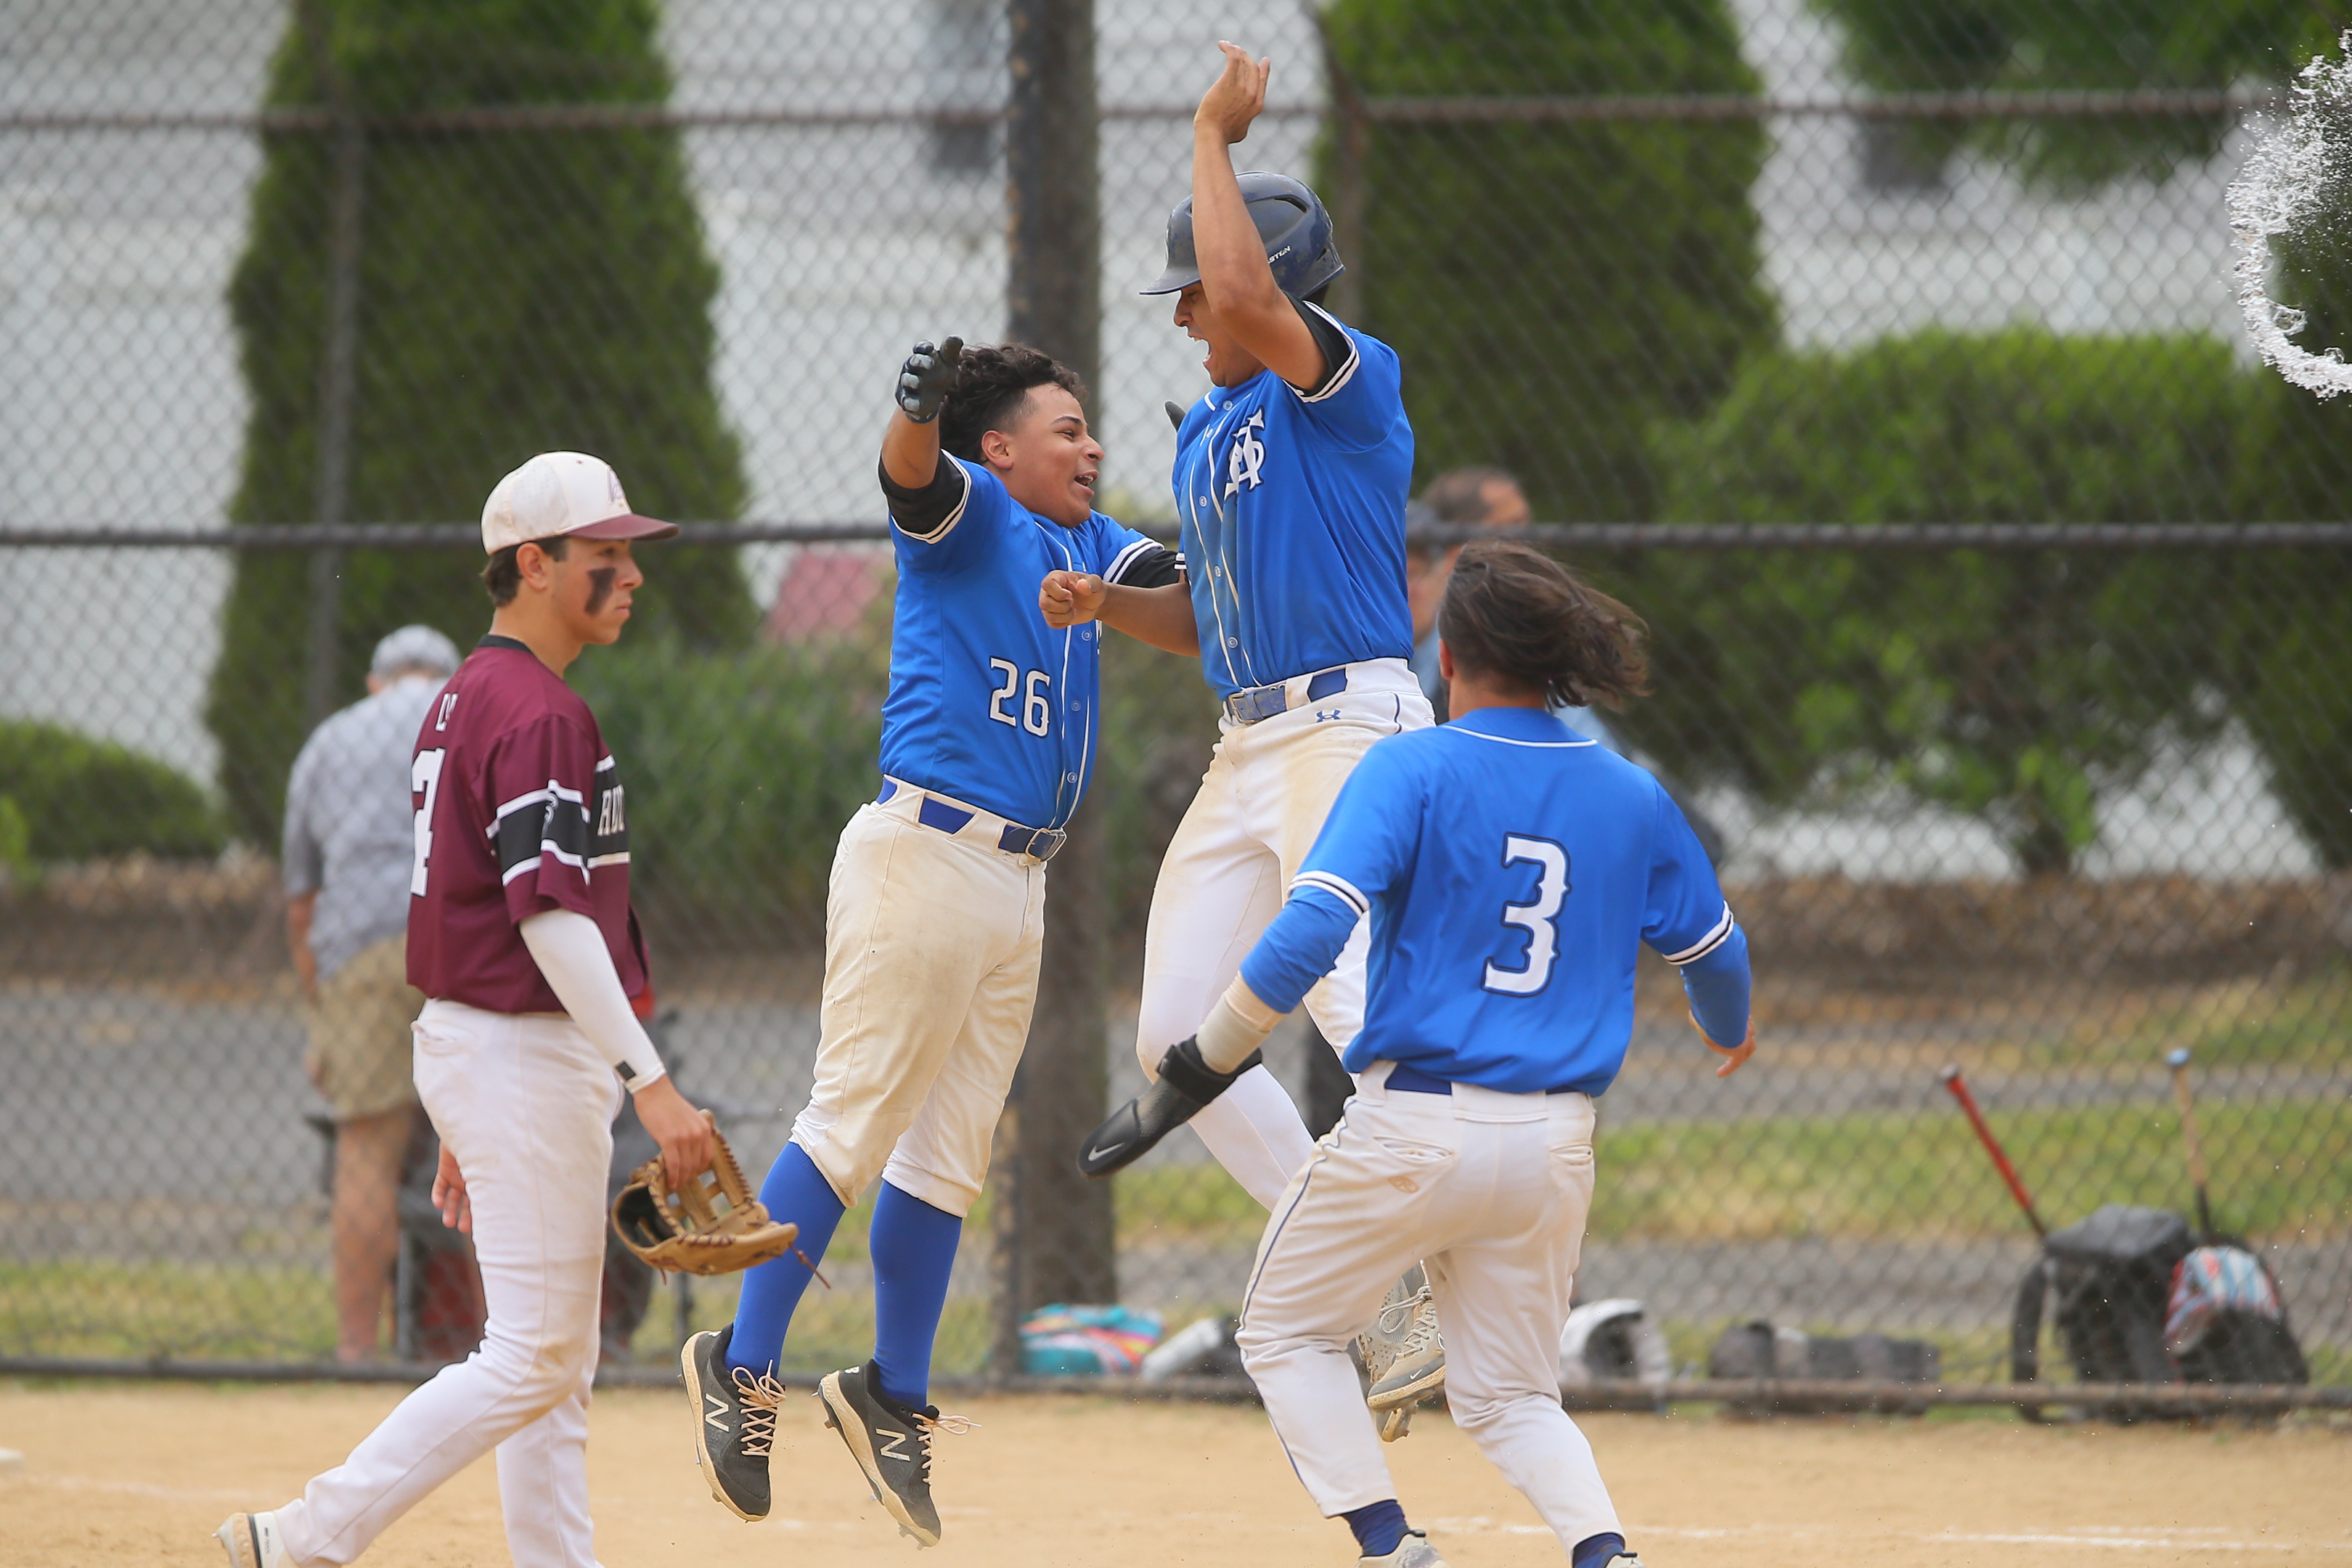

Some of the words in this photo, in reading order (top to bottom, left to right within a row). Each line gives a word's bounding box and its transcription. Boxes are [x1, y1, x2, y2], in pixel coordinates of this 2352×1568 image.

[1267, 245, 1291, 264] STON
[990, 656, 1050, 738] 26
[1482, 833, 1570, 997] 3
[705, 1393, 730, 1432] N
[875, 1428, 911, 1461] N
